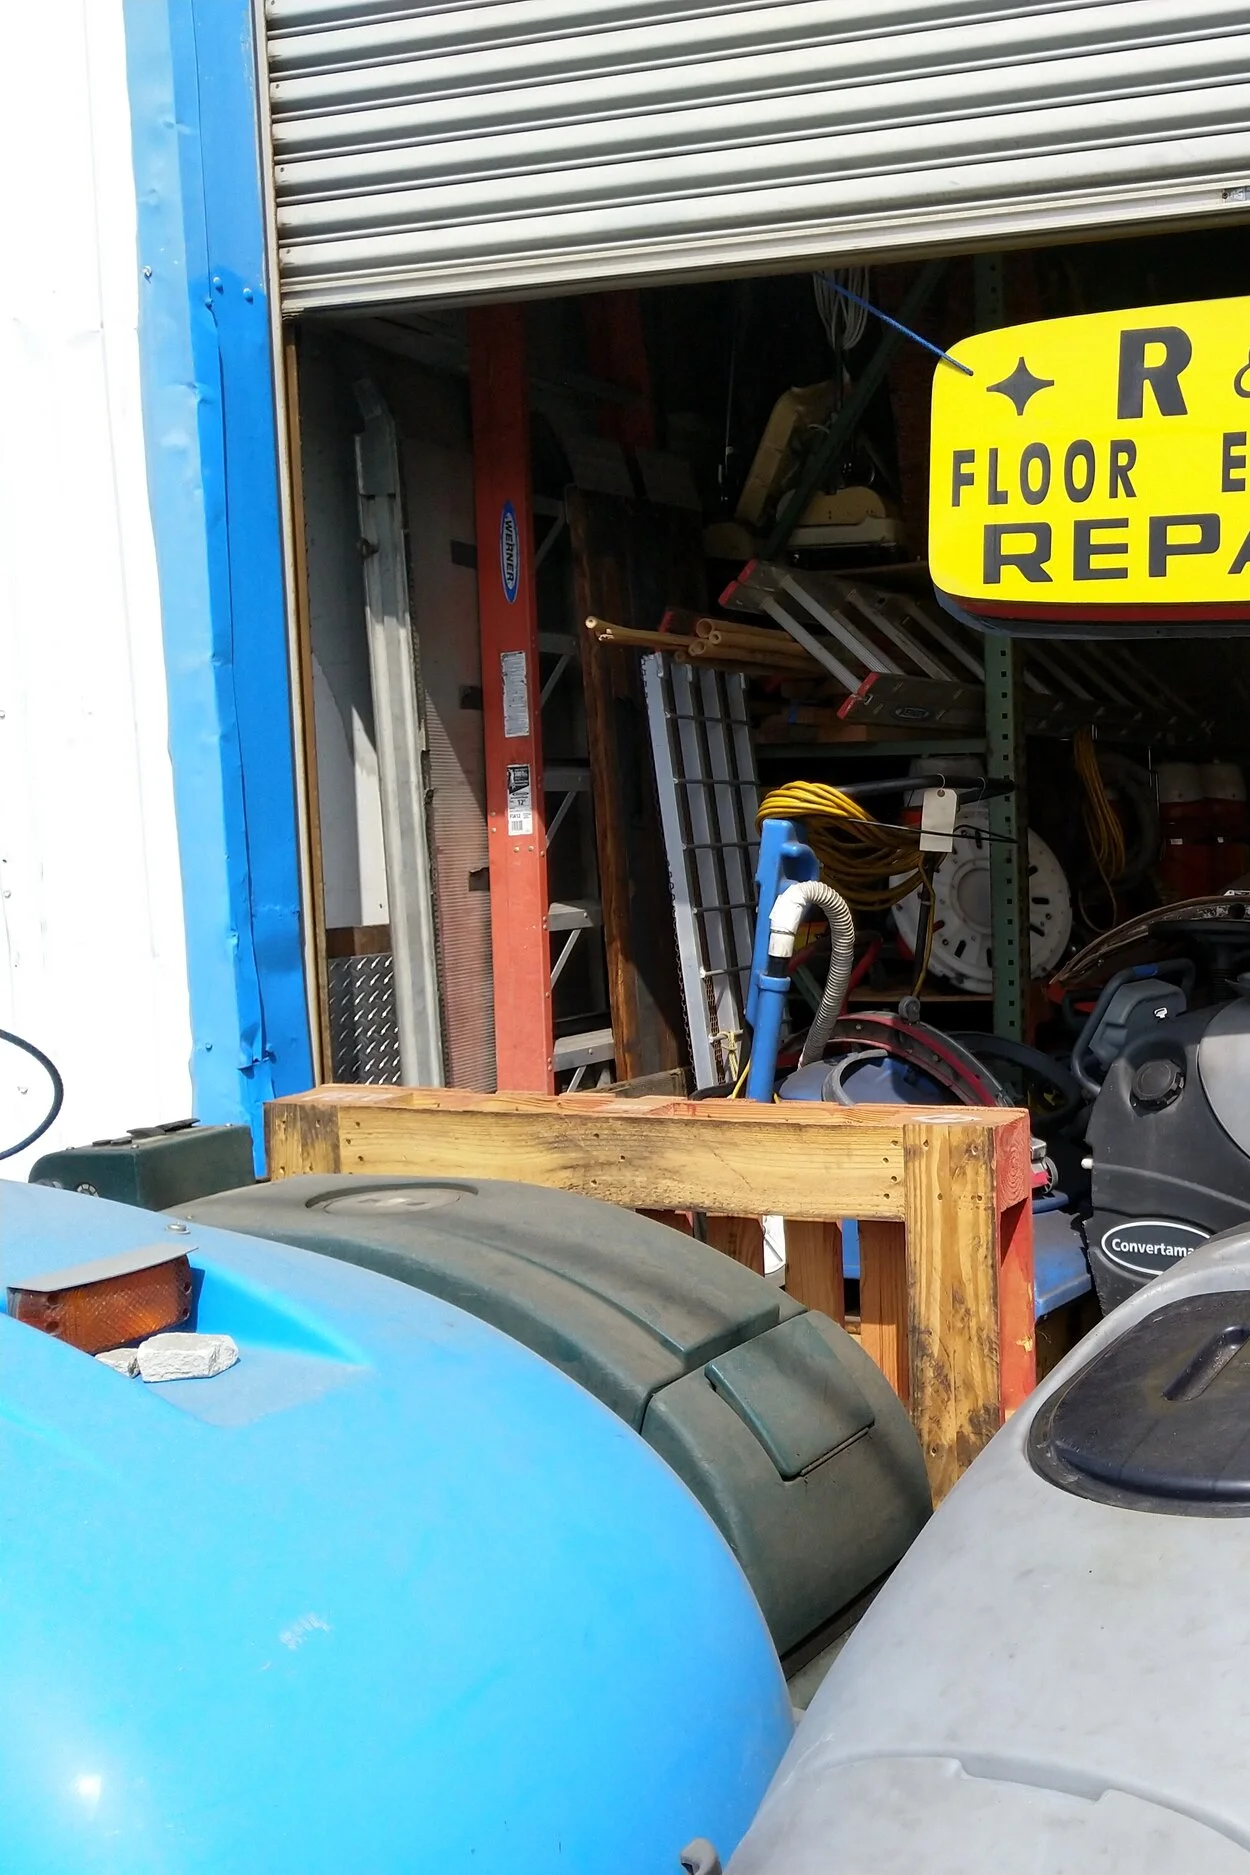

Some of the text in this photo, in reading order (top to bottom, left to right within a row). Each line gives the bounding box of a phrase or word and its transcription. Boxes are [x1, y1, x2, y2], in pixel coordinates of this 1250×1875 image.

[1117, 326, 1193, 420] R
[950, 439, 1139, 508] FLOOR
[505, 519, 514, 581] WERNER
